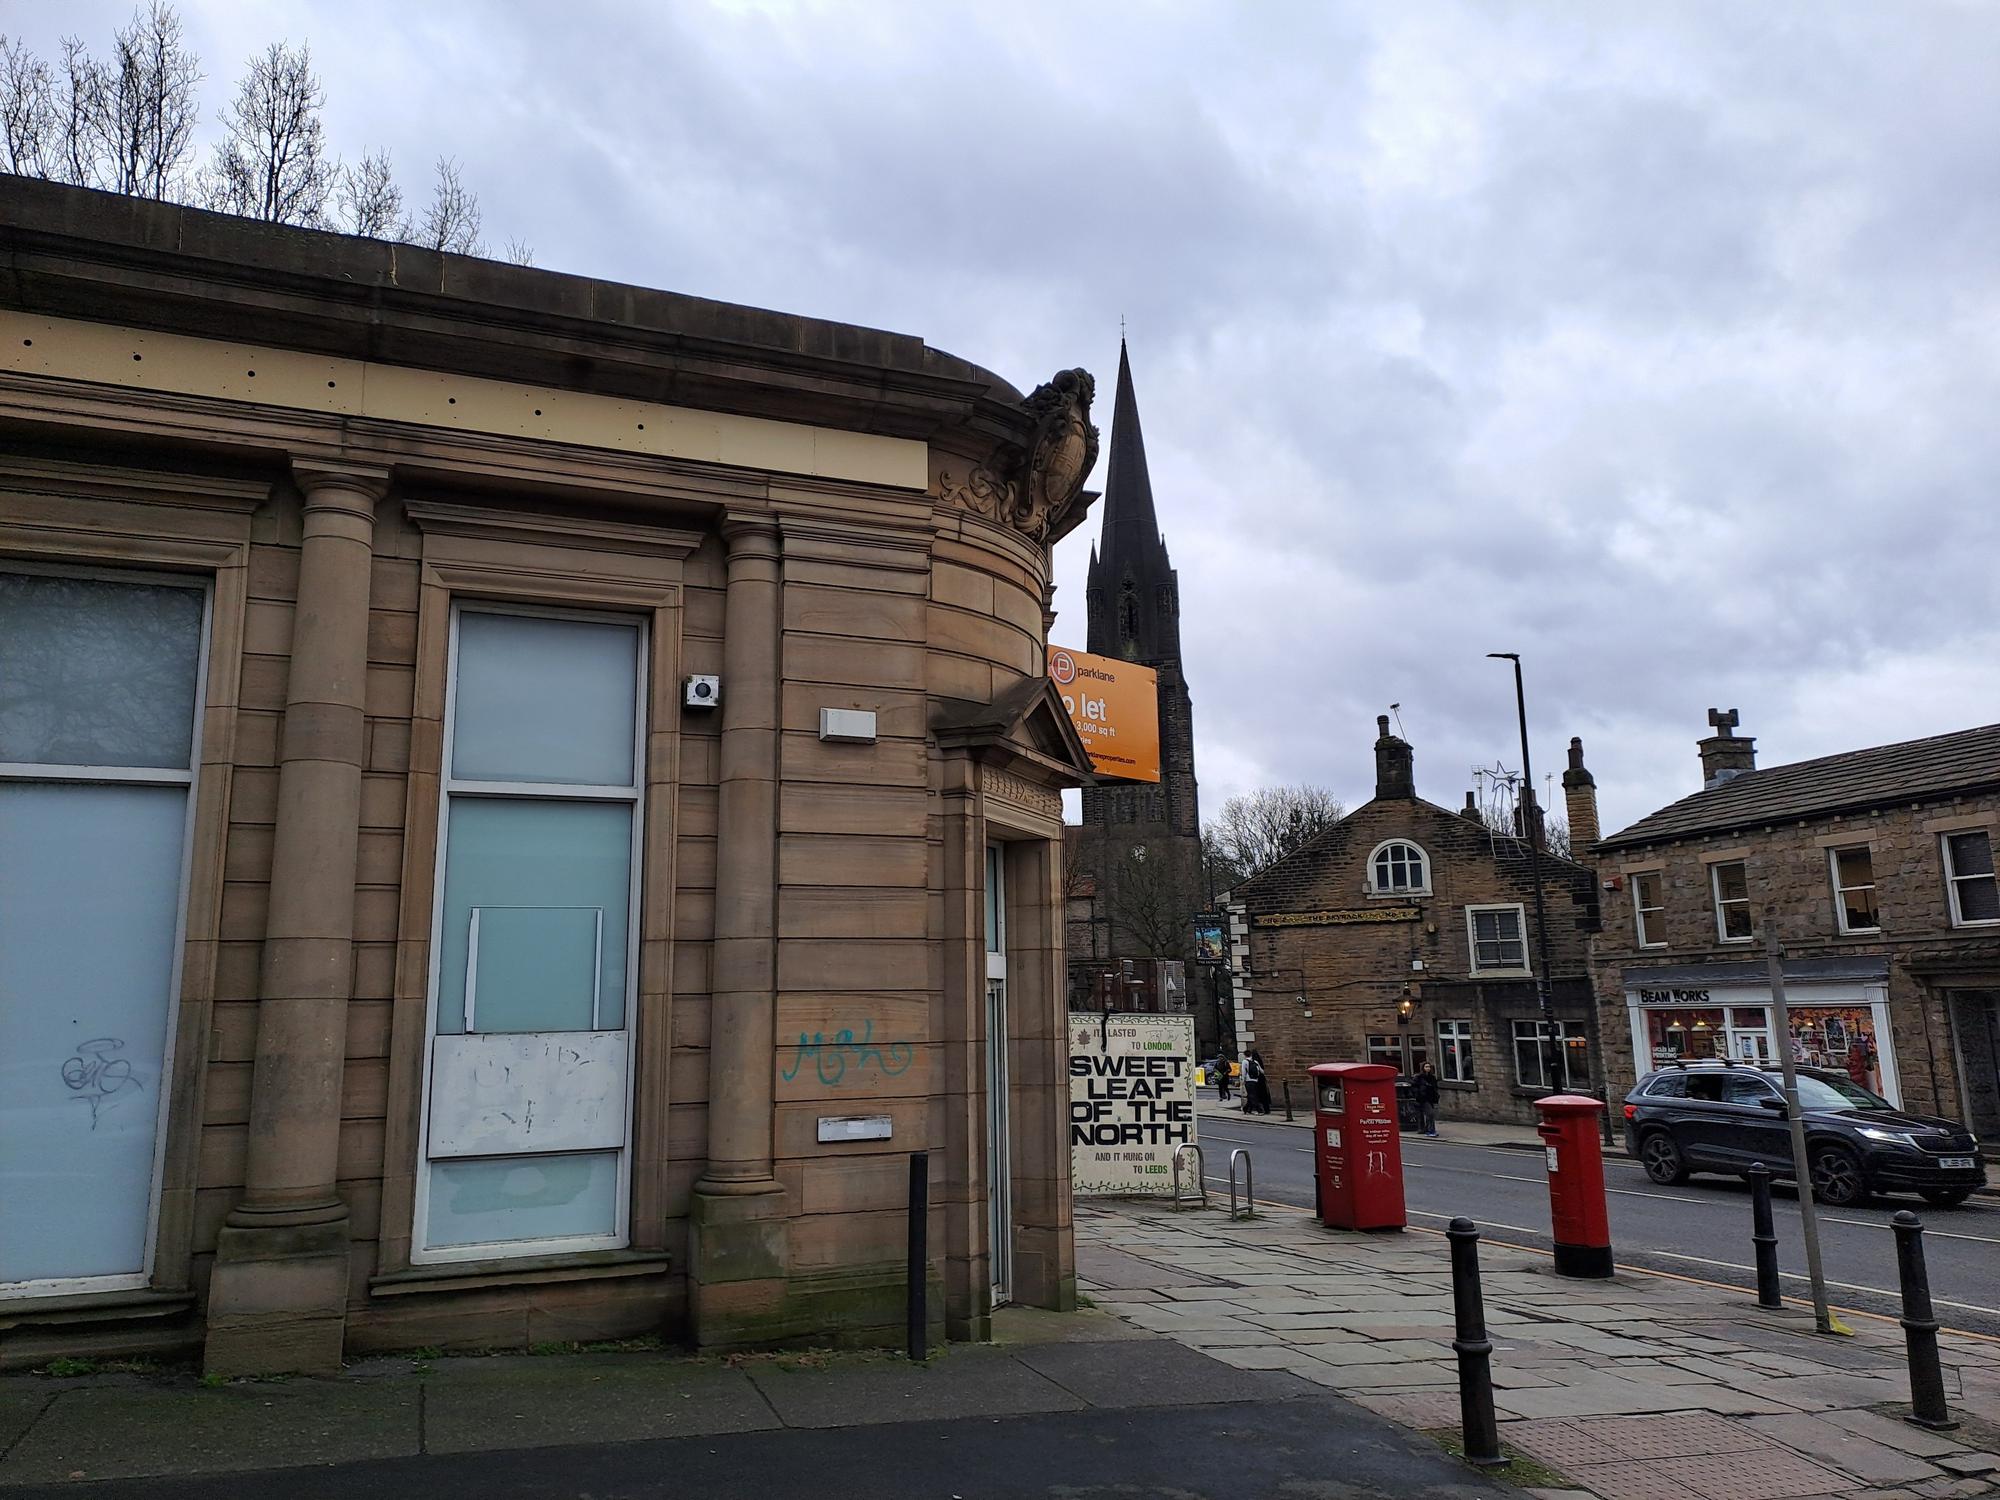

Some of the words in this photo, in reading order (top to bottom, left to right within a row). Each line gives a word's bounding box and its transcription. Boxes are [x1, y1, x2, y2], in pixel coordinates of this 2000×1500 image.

[1077, 667, 1115, 683] parklane
[1081, 693, 1106, 721] let
[1098, 726, 1108, 738] sq
[1641, 989, 1671, 1003] BEAM
[1672, 988, 1710, 1002] WORKS
[1093, 1028, 1100, 1038] IT
[1108, 1028, 1137, 1038] LASTED
[1131, 1041, 1141, 1050] TO
[1143, 1041, 1173, 1051] LONDON
[1070, 1055, 1187, 1077] SWEET
[1087, 1078, 1174, 1100] LEAF
[1071, 1101, 1112, 1123] OF
[1127, 1101, 1192, 1122] THE
[1071, 1123, 1188, 1146] NORTH
[1095, 1152, 1111, 1162] AND
[1113, 1152, 1120, 1161] IT
[1122, 1152, 1143, 1162] HUNG
[1144, 1152, 1155, 1162] ON
[1133, 1165, 1143, 1174] TO
[1145, 1165, 1168, 1174] LEEDS
